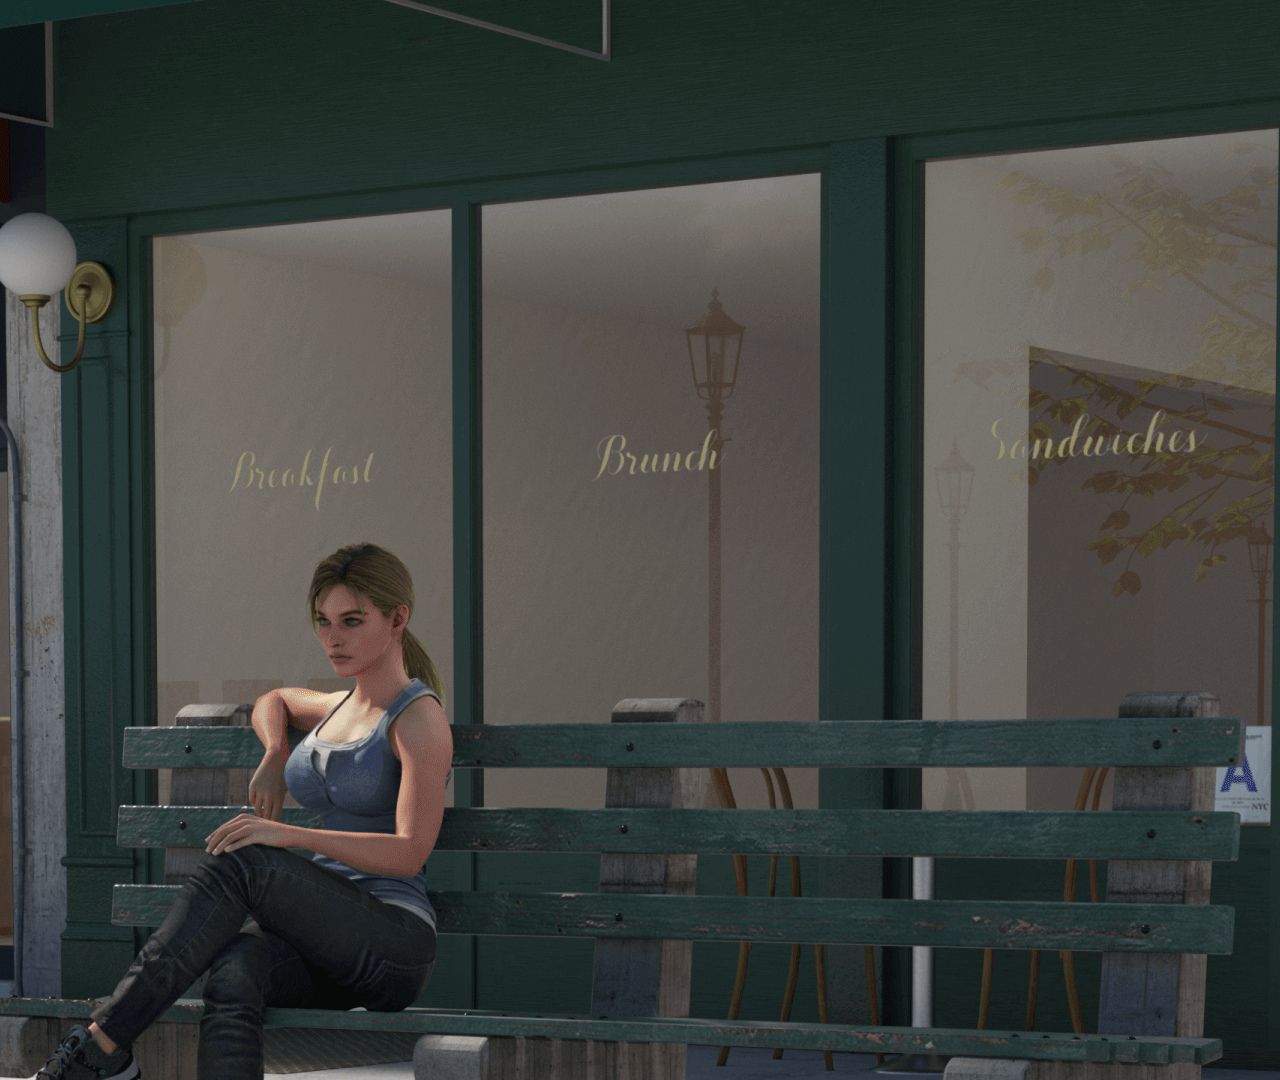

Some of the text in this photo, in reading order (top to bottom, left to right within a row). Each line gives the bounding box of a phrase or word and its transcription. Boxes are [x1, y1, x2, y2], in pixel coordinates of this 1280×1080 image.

[591, 428, 727, 482] Brunch
[991, 409, 1208, 461] Sandwiches
[229, 446, 378, 512] Breakfast
[1220, 752, 1258, 792] A
